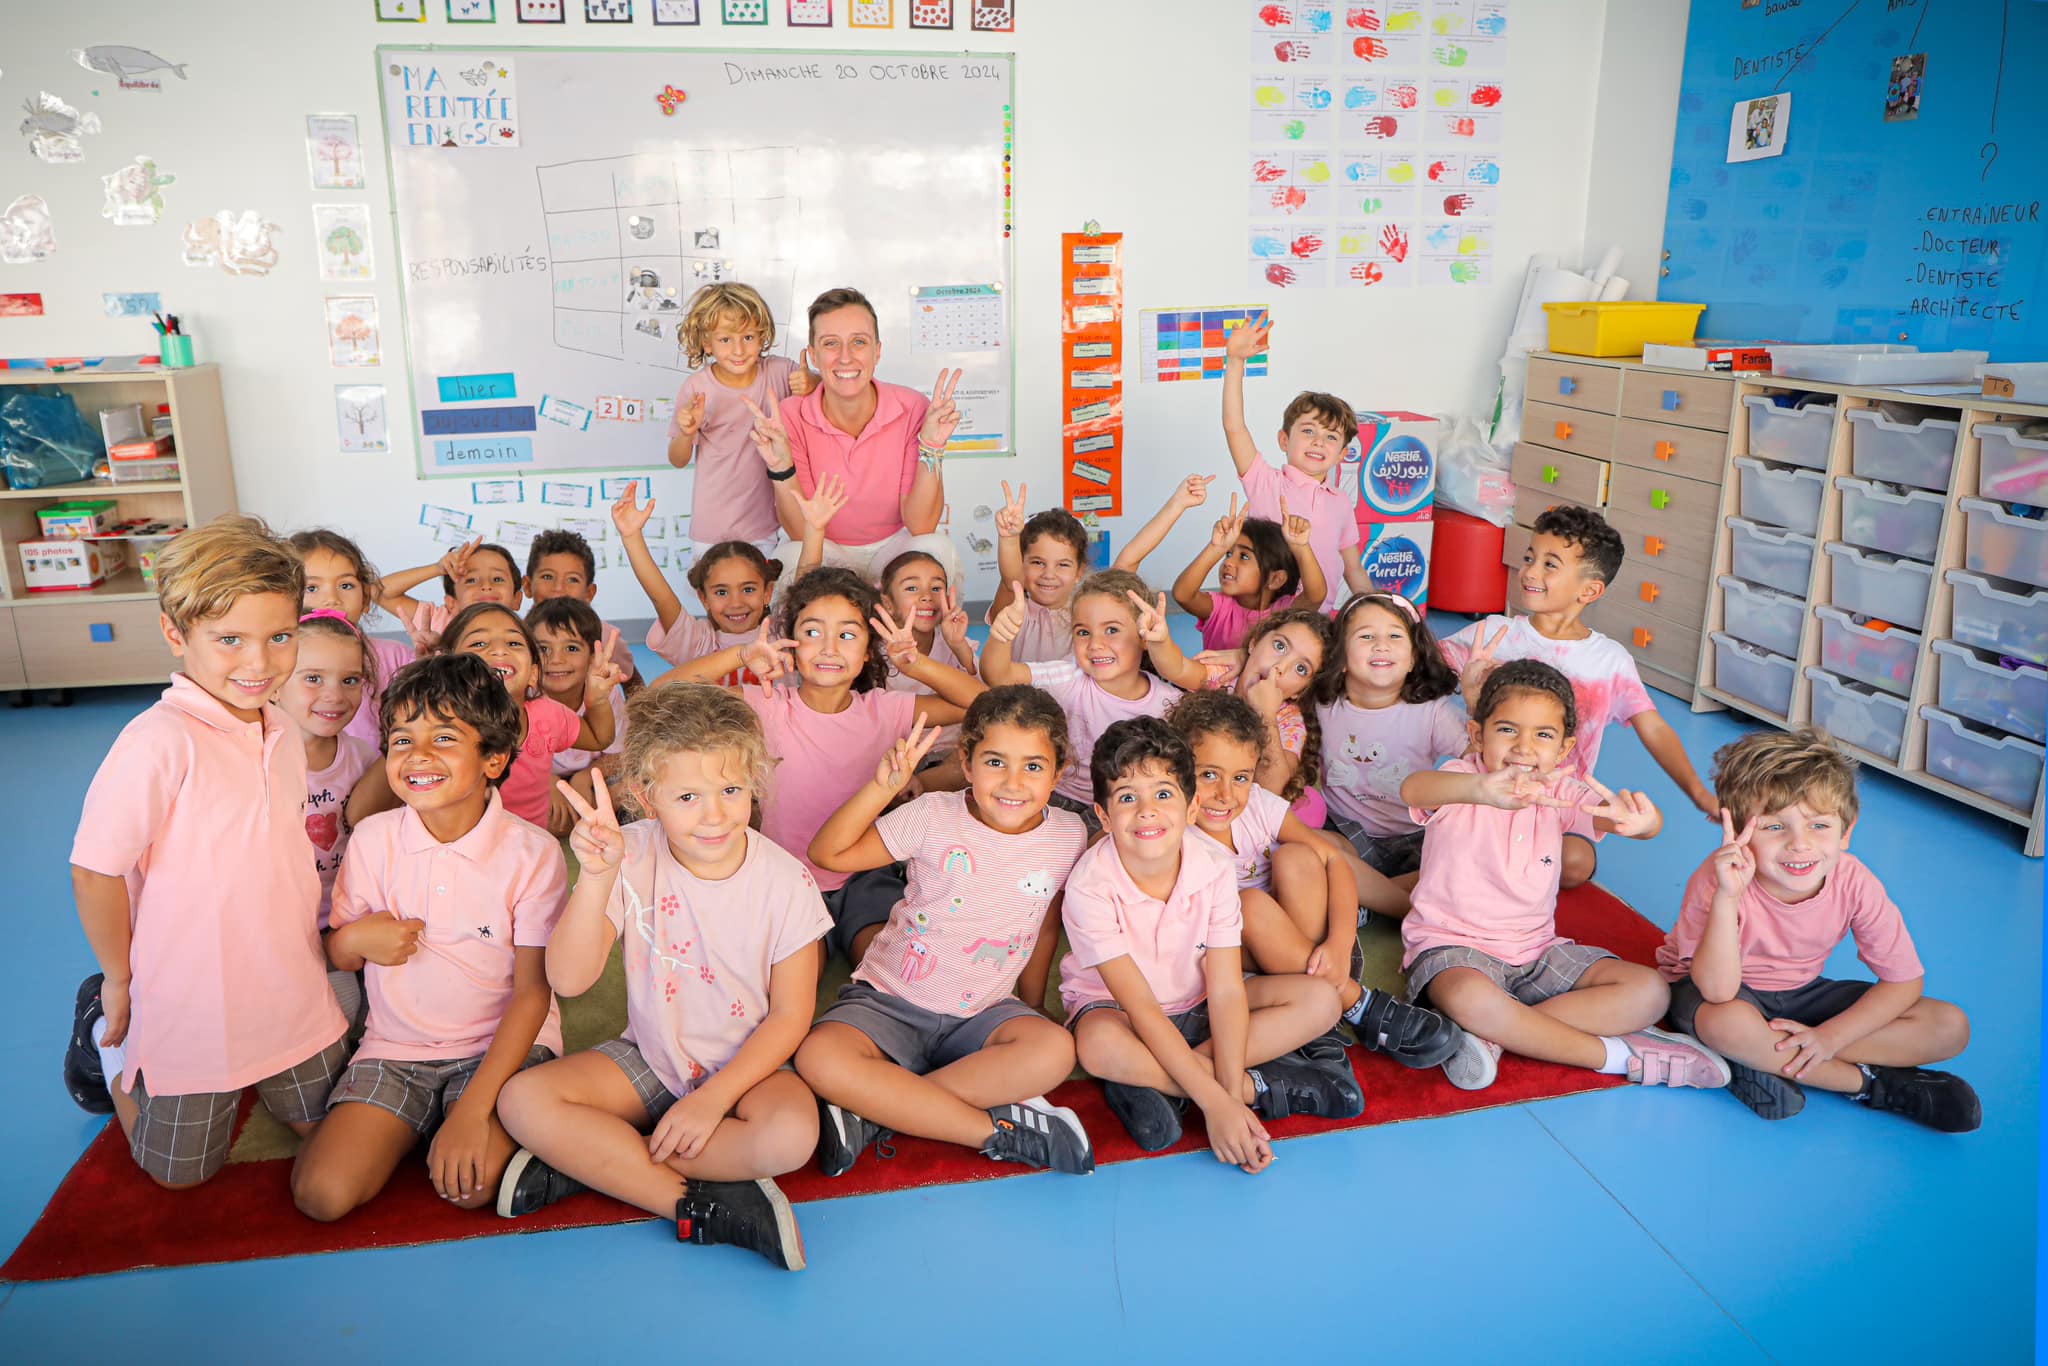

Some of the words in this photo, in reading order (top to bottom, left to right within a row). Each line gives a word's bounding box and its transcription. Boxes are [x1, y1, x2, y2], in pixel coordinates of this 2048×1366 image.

[403, 66, 447, 91] MA
[835, 64, 858, 80] 20
[870, 64, 951, 80] OCTOBRE
[961, 64, 1000, 80] 2024
[406, 89, 513, 120] RENTRÉE
[407, 123, 441, 146] EN
[456, 376, 497, 399] hier
[446, 440, 518, 462] demain
